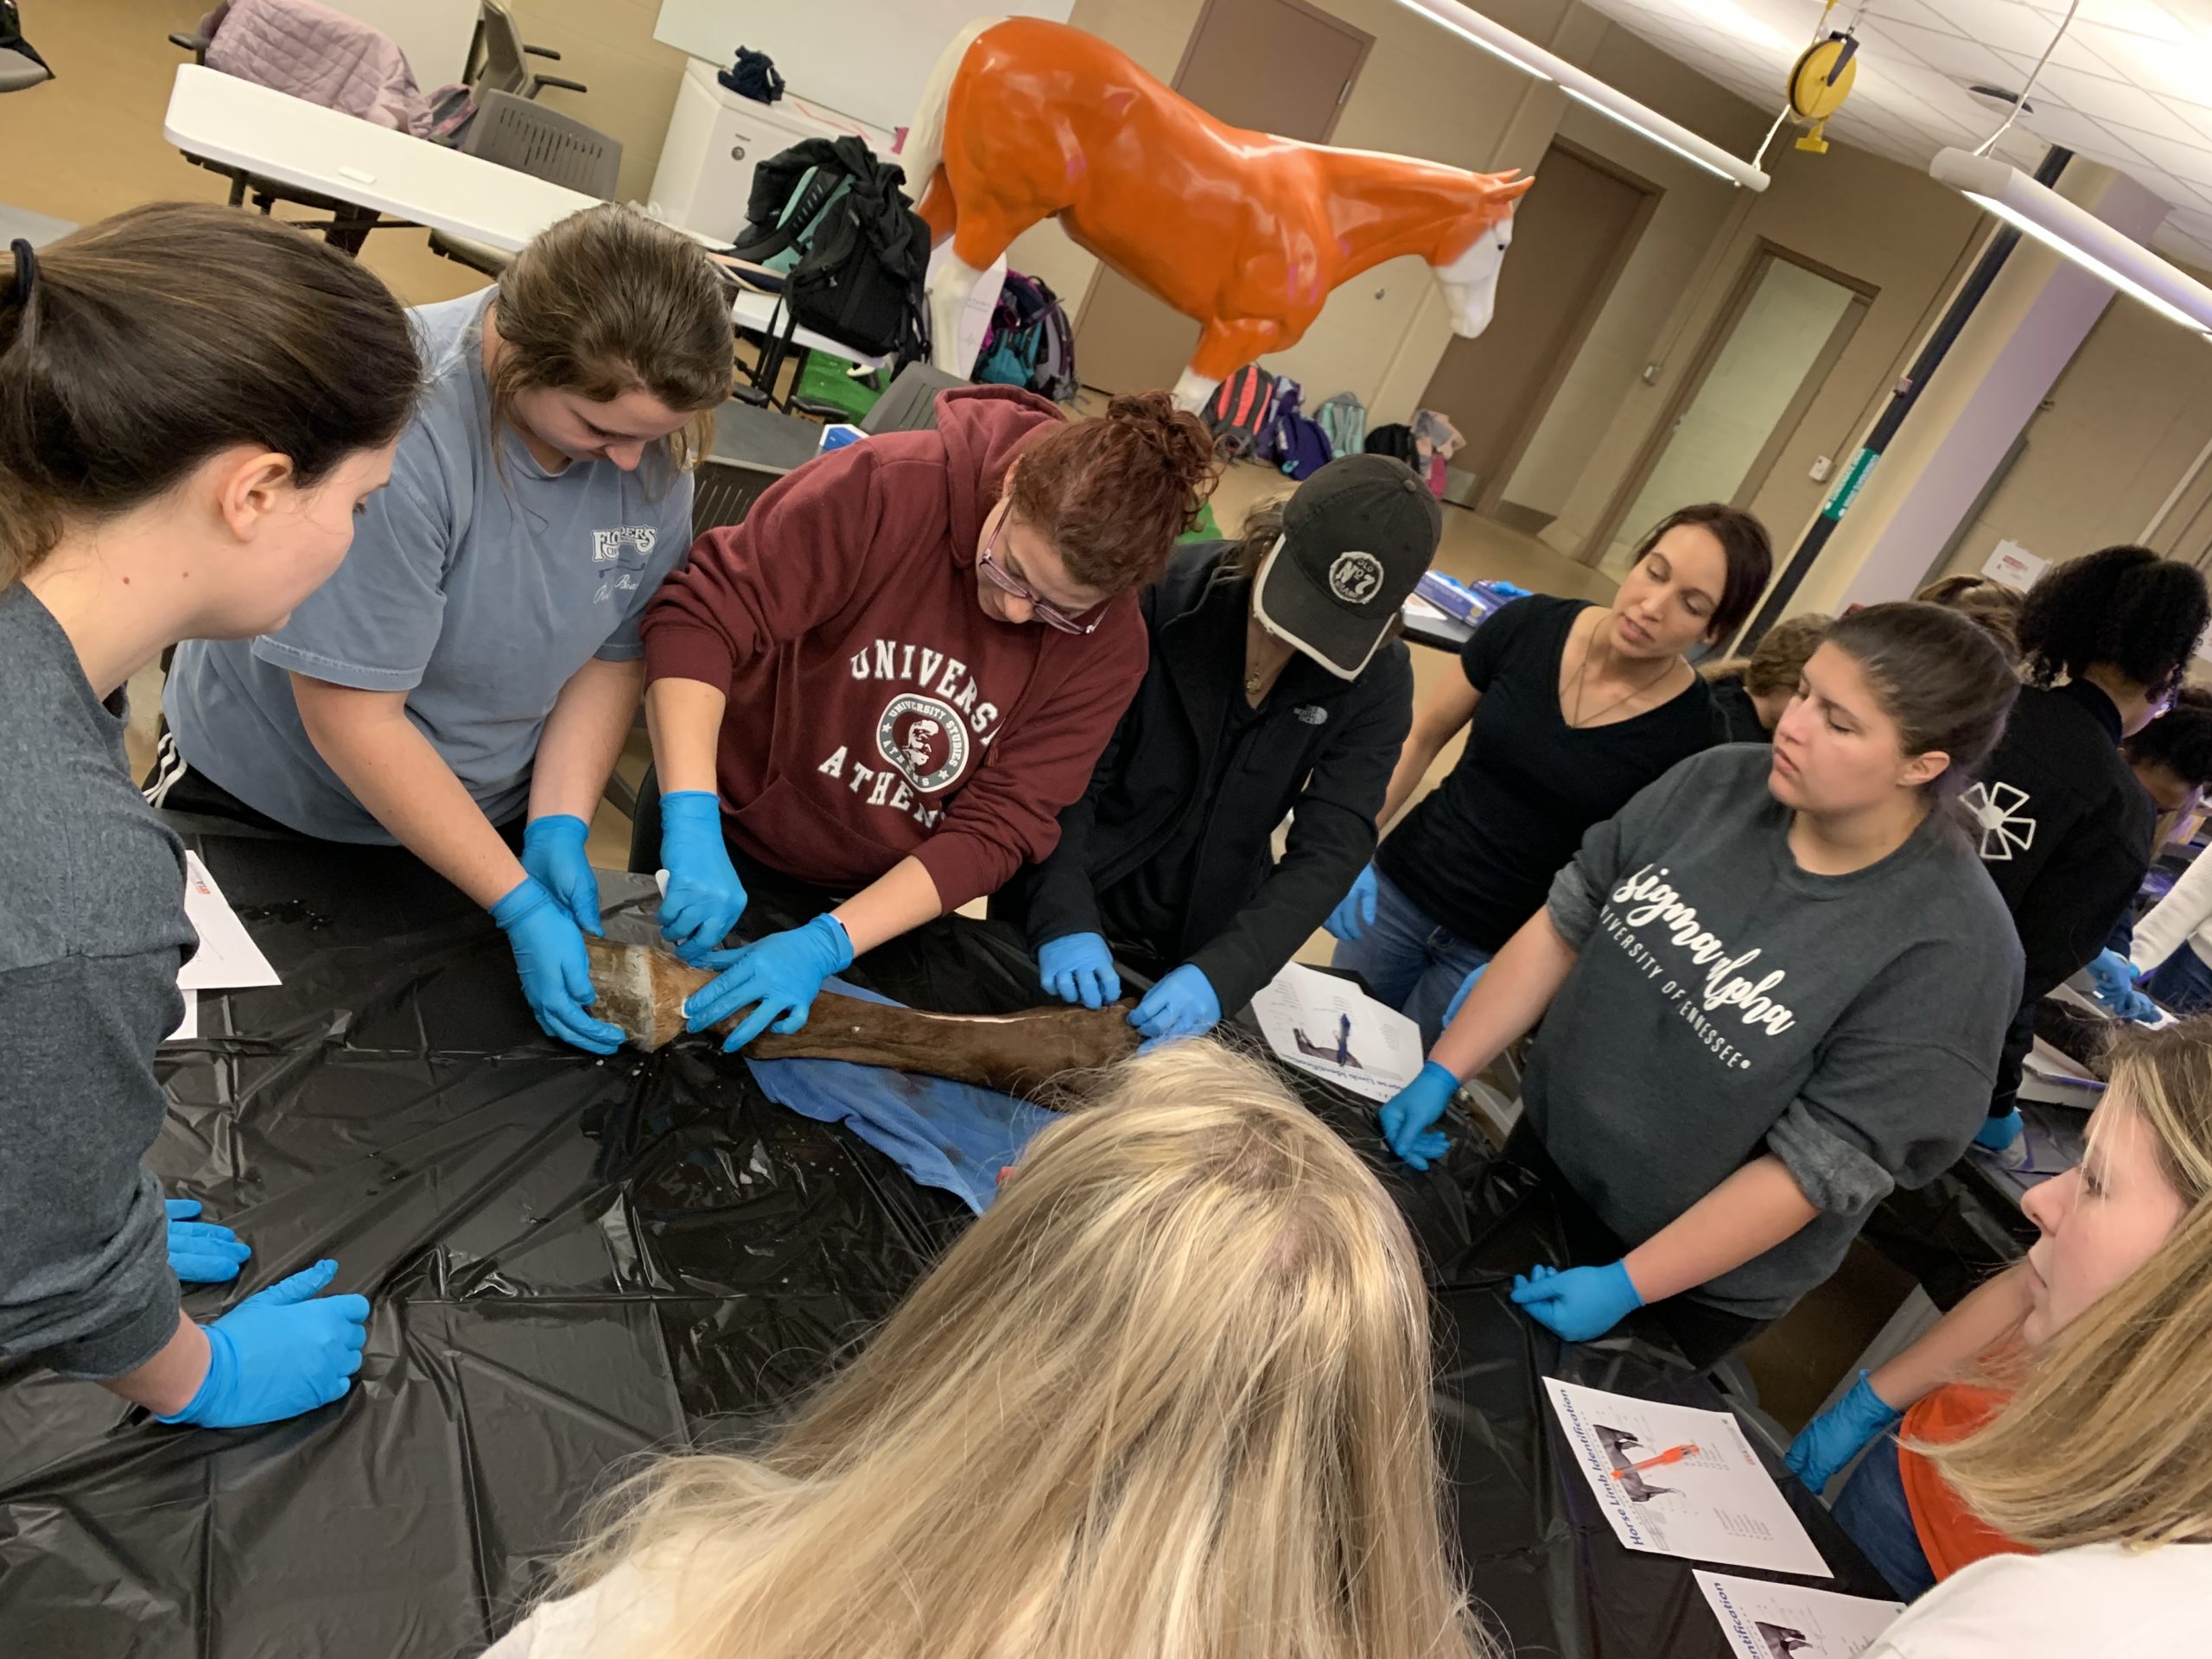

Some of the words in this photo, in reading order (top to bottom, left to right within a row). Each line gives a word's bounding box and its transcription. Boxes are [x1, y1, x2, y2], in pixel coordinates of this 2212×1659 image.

[1355, 575, 1376, 594] 7
[1357, 559, 1374, 572] OLD
[888, 700, 946, 720] UNIVERSITY
[945, 720, 963, 766] STUDIES
[817, 746, 946, 829] ATHEN
[1599, 904, 1662, 980] NIVERSITY
[1661, 980, 1686, 1001] OF
[1679, 999, 1742, 1068] ENNESSEE
[1560, 1389, 1602, 1471] Identification
[1598, 1477, 1620, 1506] Limb
[1618, 1508, 1644, 1545] Horse
